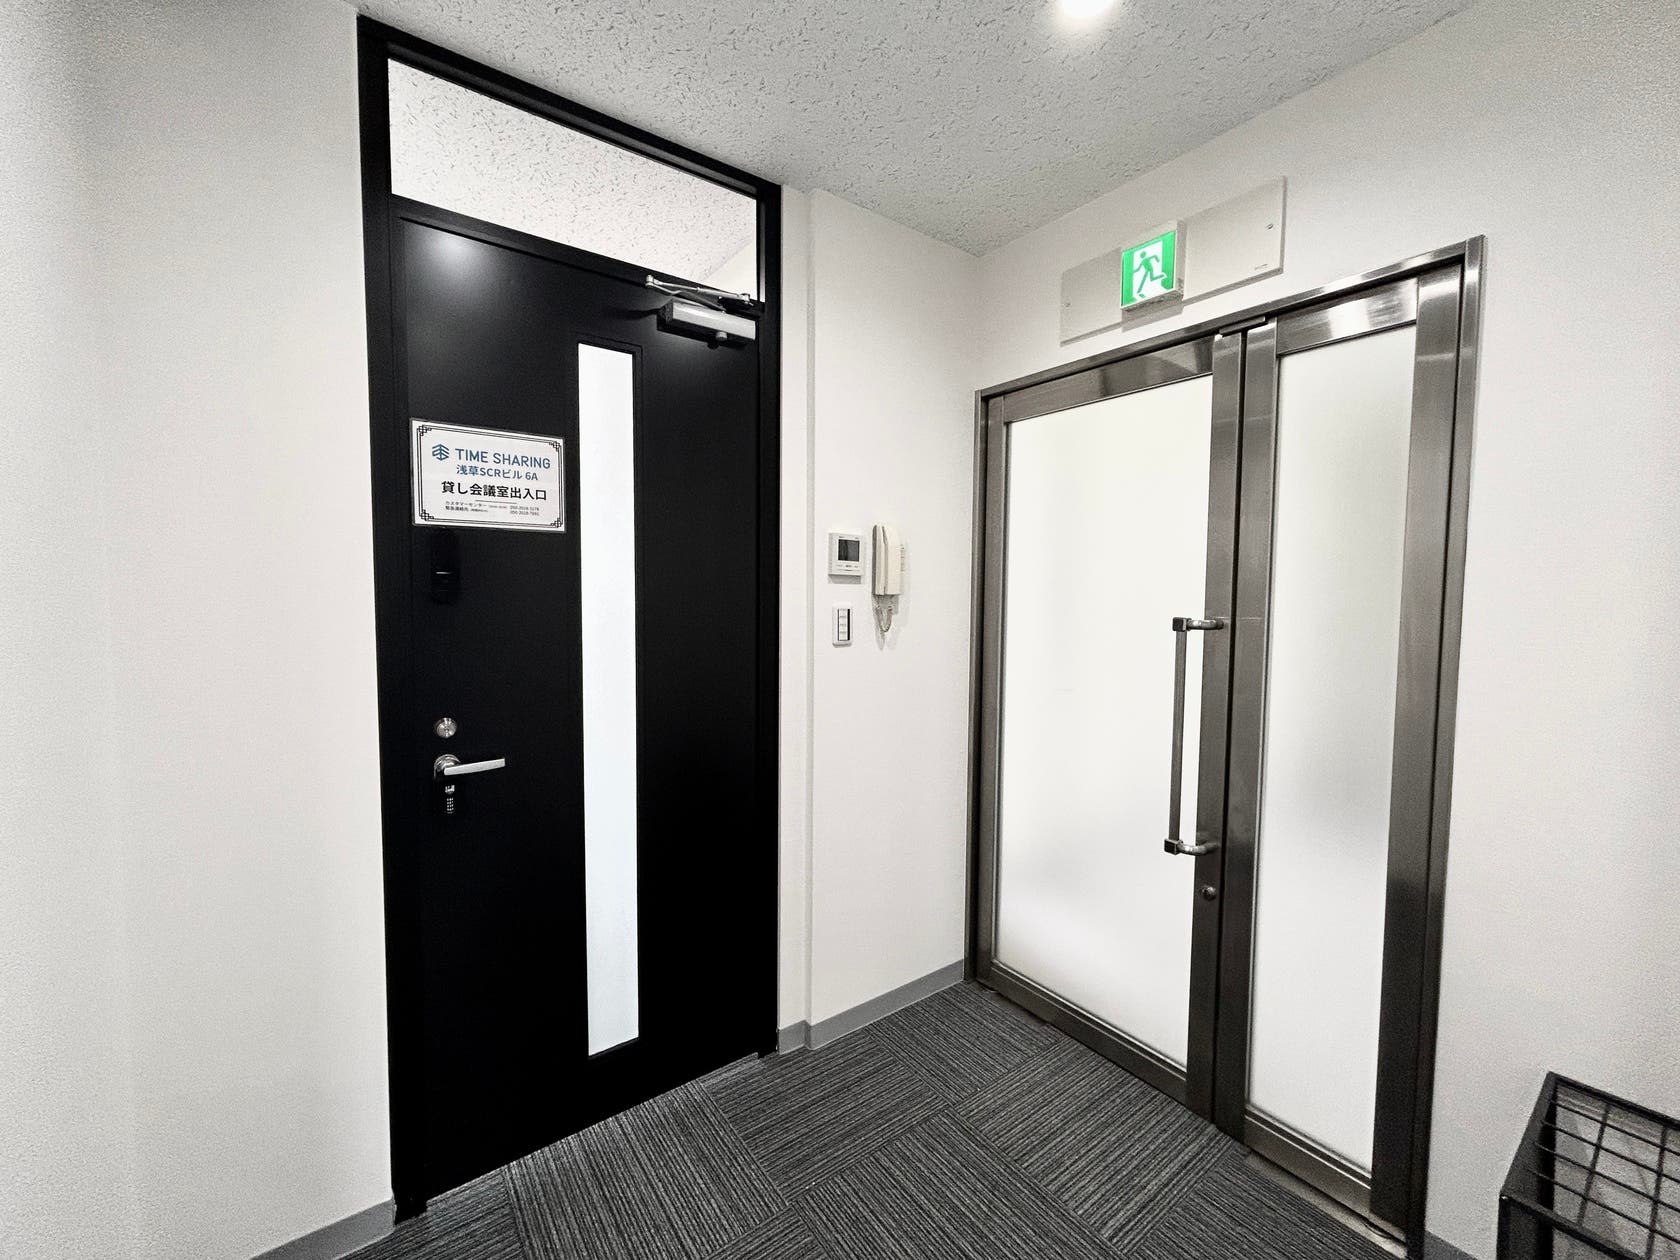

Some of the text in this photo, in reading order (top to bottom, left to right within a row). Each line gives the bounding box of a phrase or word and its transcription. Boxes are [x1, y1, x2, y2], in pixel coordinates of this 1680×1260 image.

[455, 448, 551, 469] TIME SHARING
[456, 464, 538, 481] 浅草SCRビル 6A
[441, 481, 547, 500] 貸し会議室出入口
